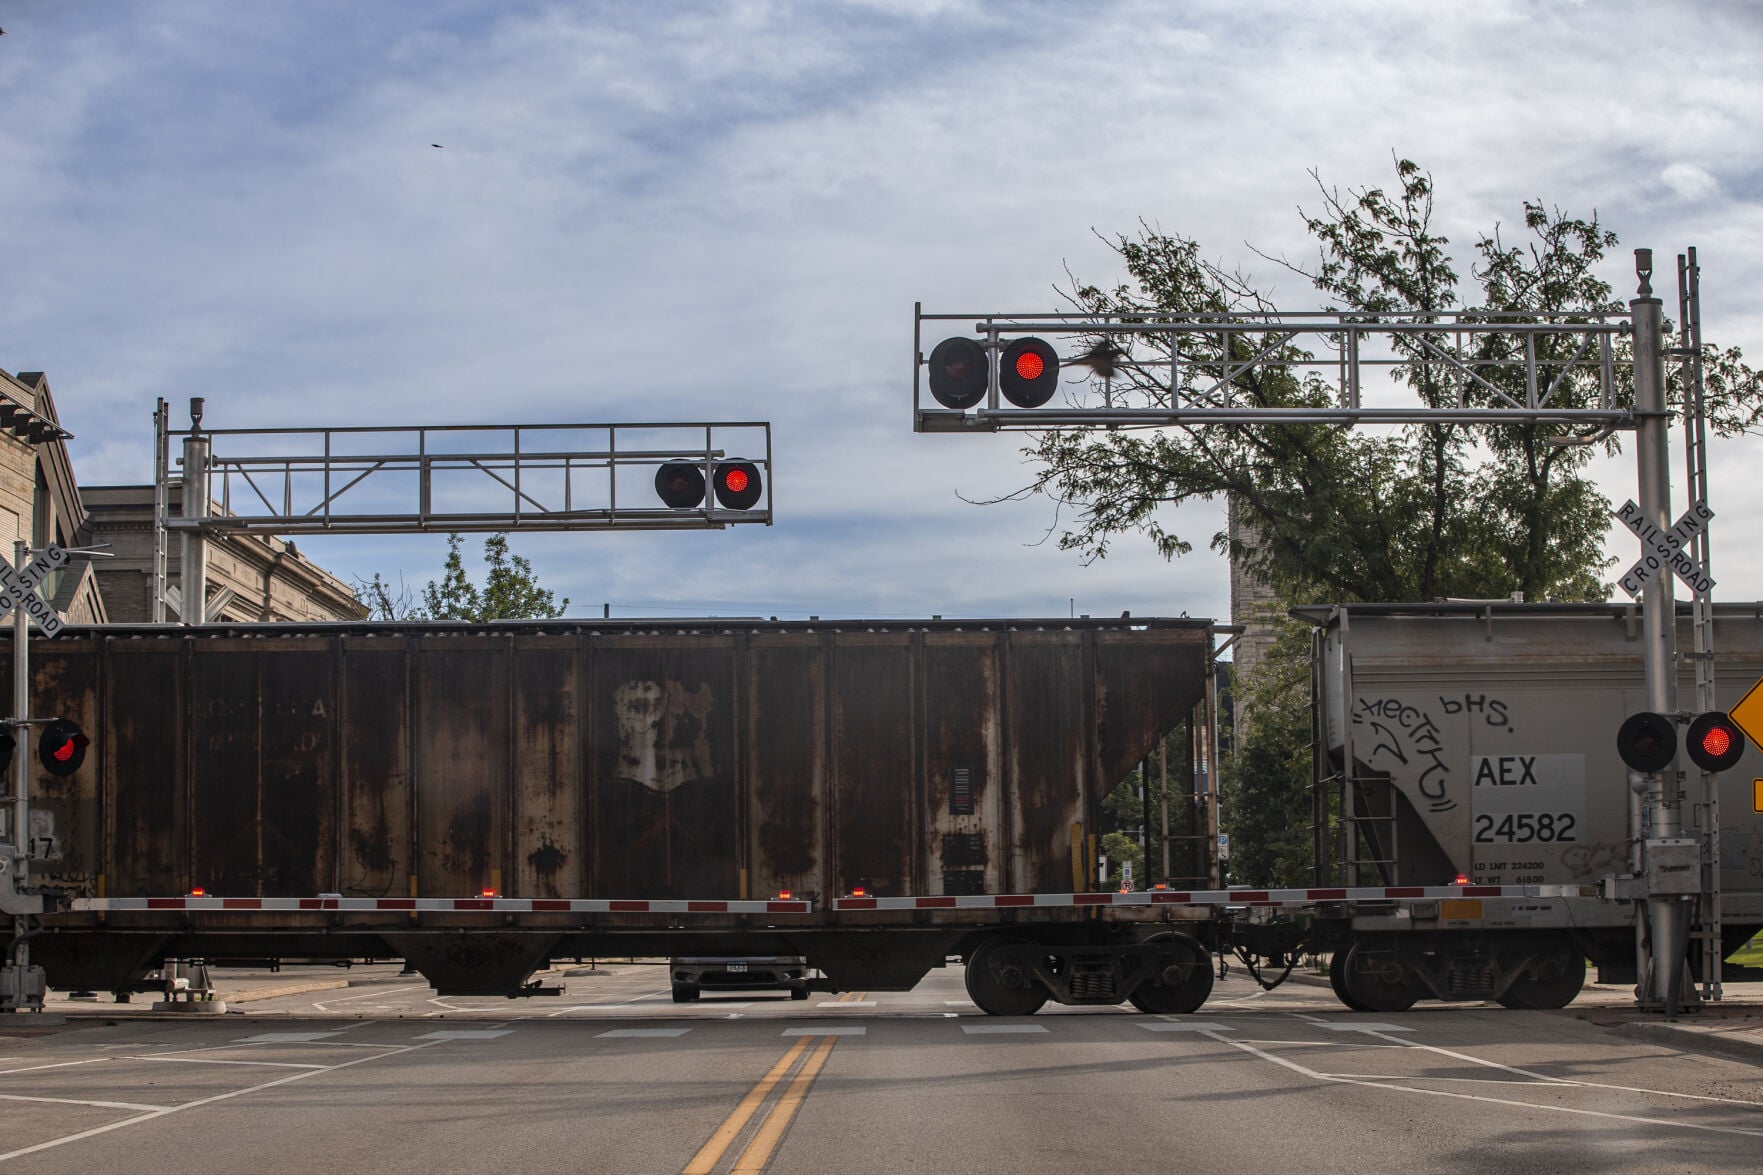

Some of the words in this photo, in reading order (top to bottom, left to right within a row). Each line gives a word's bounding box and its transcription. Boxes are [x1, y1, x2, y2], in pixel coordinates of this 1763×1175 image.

[1620, 504, 1657, 546] RAIL
[1670, 552, 1710, 593] ROAD
[1624, 505, 1709, 592] CROSSING
[0, 547, 61, 616] OSSING
[0, 565, 12, 586] IL
[22, 592, 59, 632] ROAD
[1475, 756, 1537, 786] AEX
[1475, 813, 1576, 843] 24582
[1474, 863, 1486, 871] LD
[1490, 863, 1507, 871] LMT
[1488, 876, 1501, 884] WT
[1516, 876, 1544, 884] 61800
